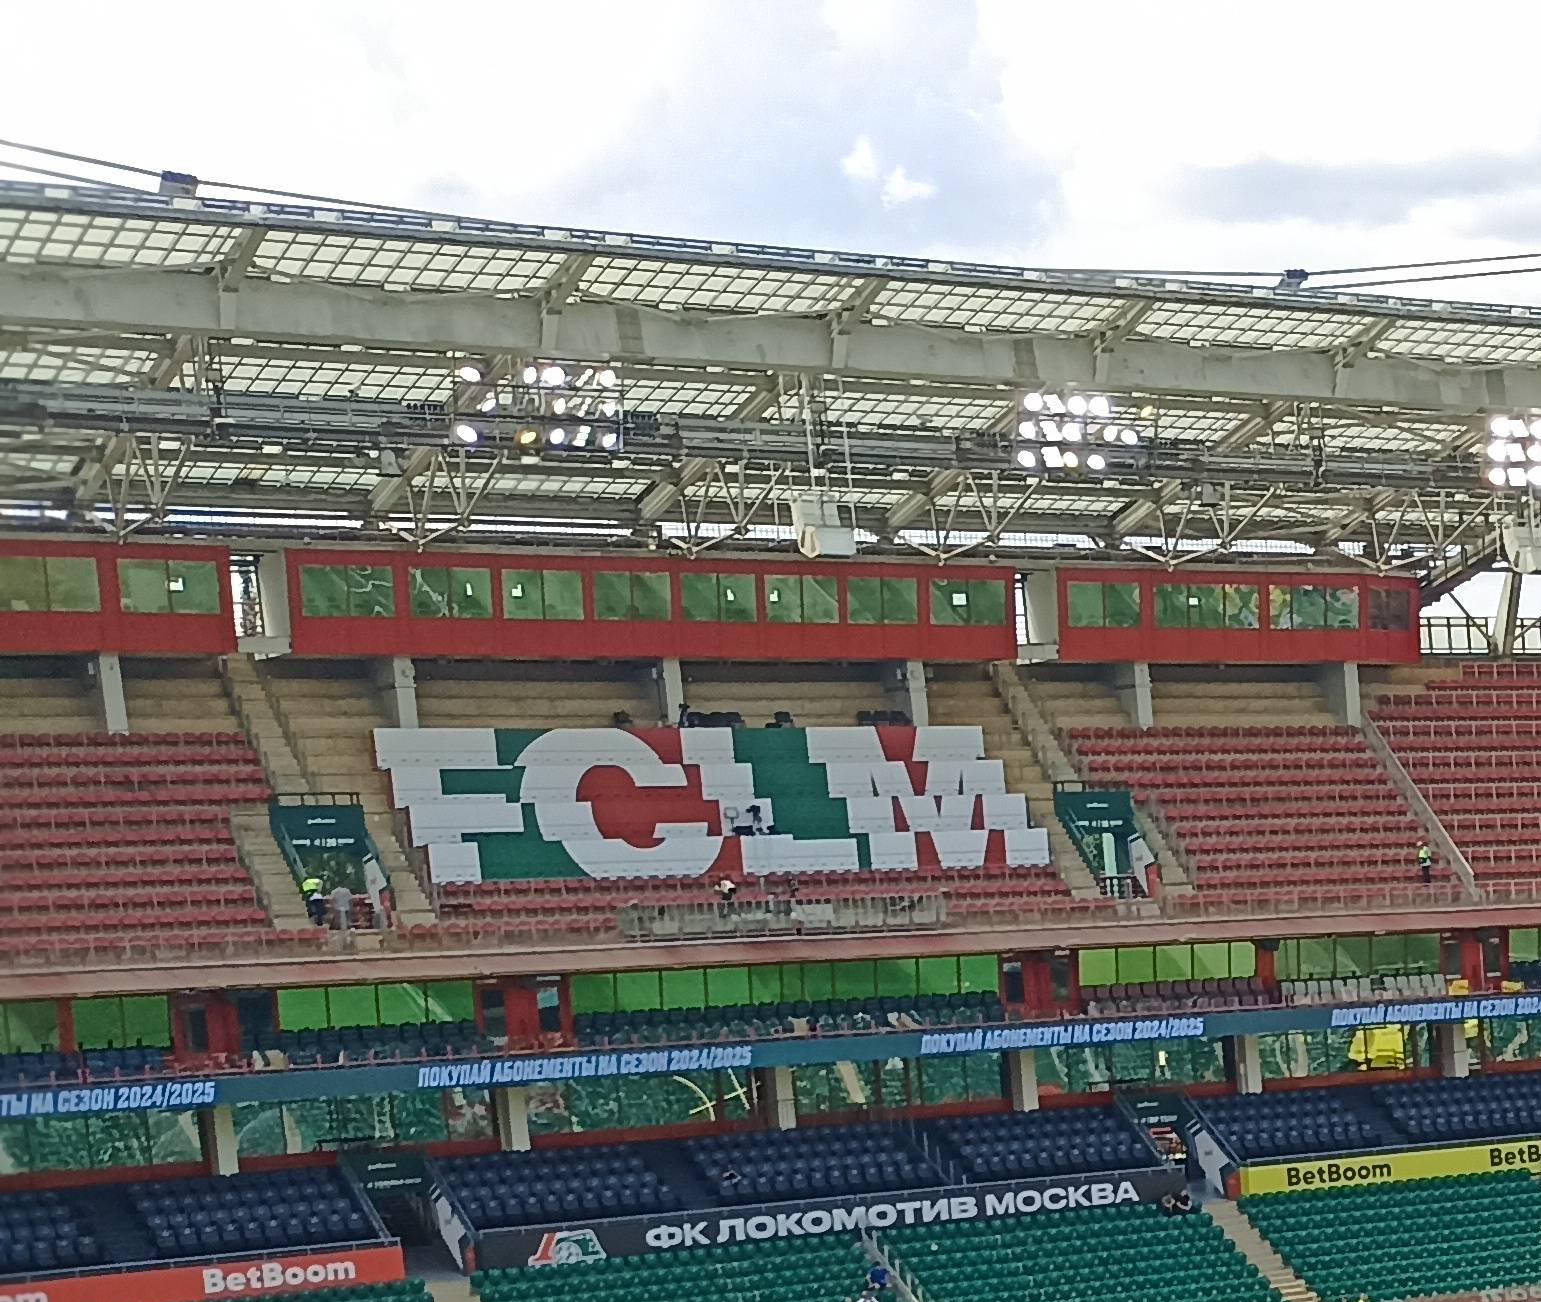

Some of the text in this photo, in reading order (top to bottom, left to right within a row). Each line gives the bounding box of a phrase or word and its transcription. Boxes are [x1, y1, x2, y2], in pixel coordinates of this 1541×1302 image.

[372, 726, 1050, 883] FCLM
[1074, 1023, 1090, 1044] НА
[1091, 1020, 1133, 1042] СЕЗОН
[418, 1045, 752, 1088] ПОКУПАЙ АБОНЕМЕНТЫ НА СЕЗОН 2024/2025
[30, 1092, 54, 1117] НА
[58, 1087, 115, 1113] СЕЗОН
[117, 1081, 215, 1108] 2024/2025
[1286, 1159, 1392, 1186] BetBoom
[646, 1181, 1140, 1248] ФК ЛОКОМОТИВ МОСКВА
[203, 1260, 356, 1294] BetBoom
